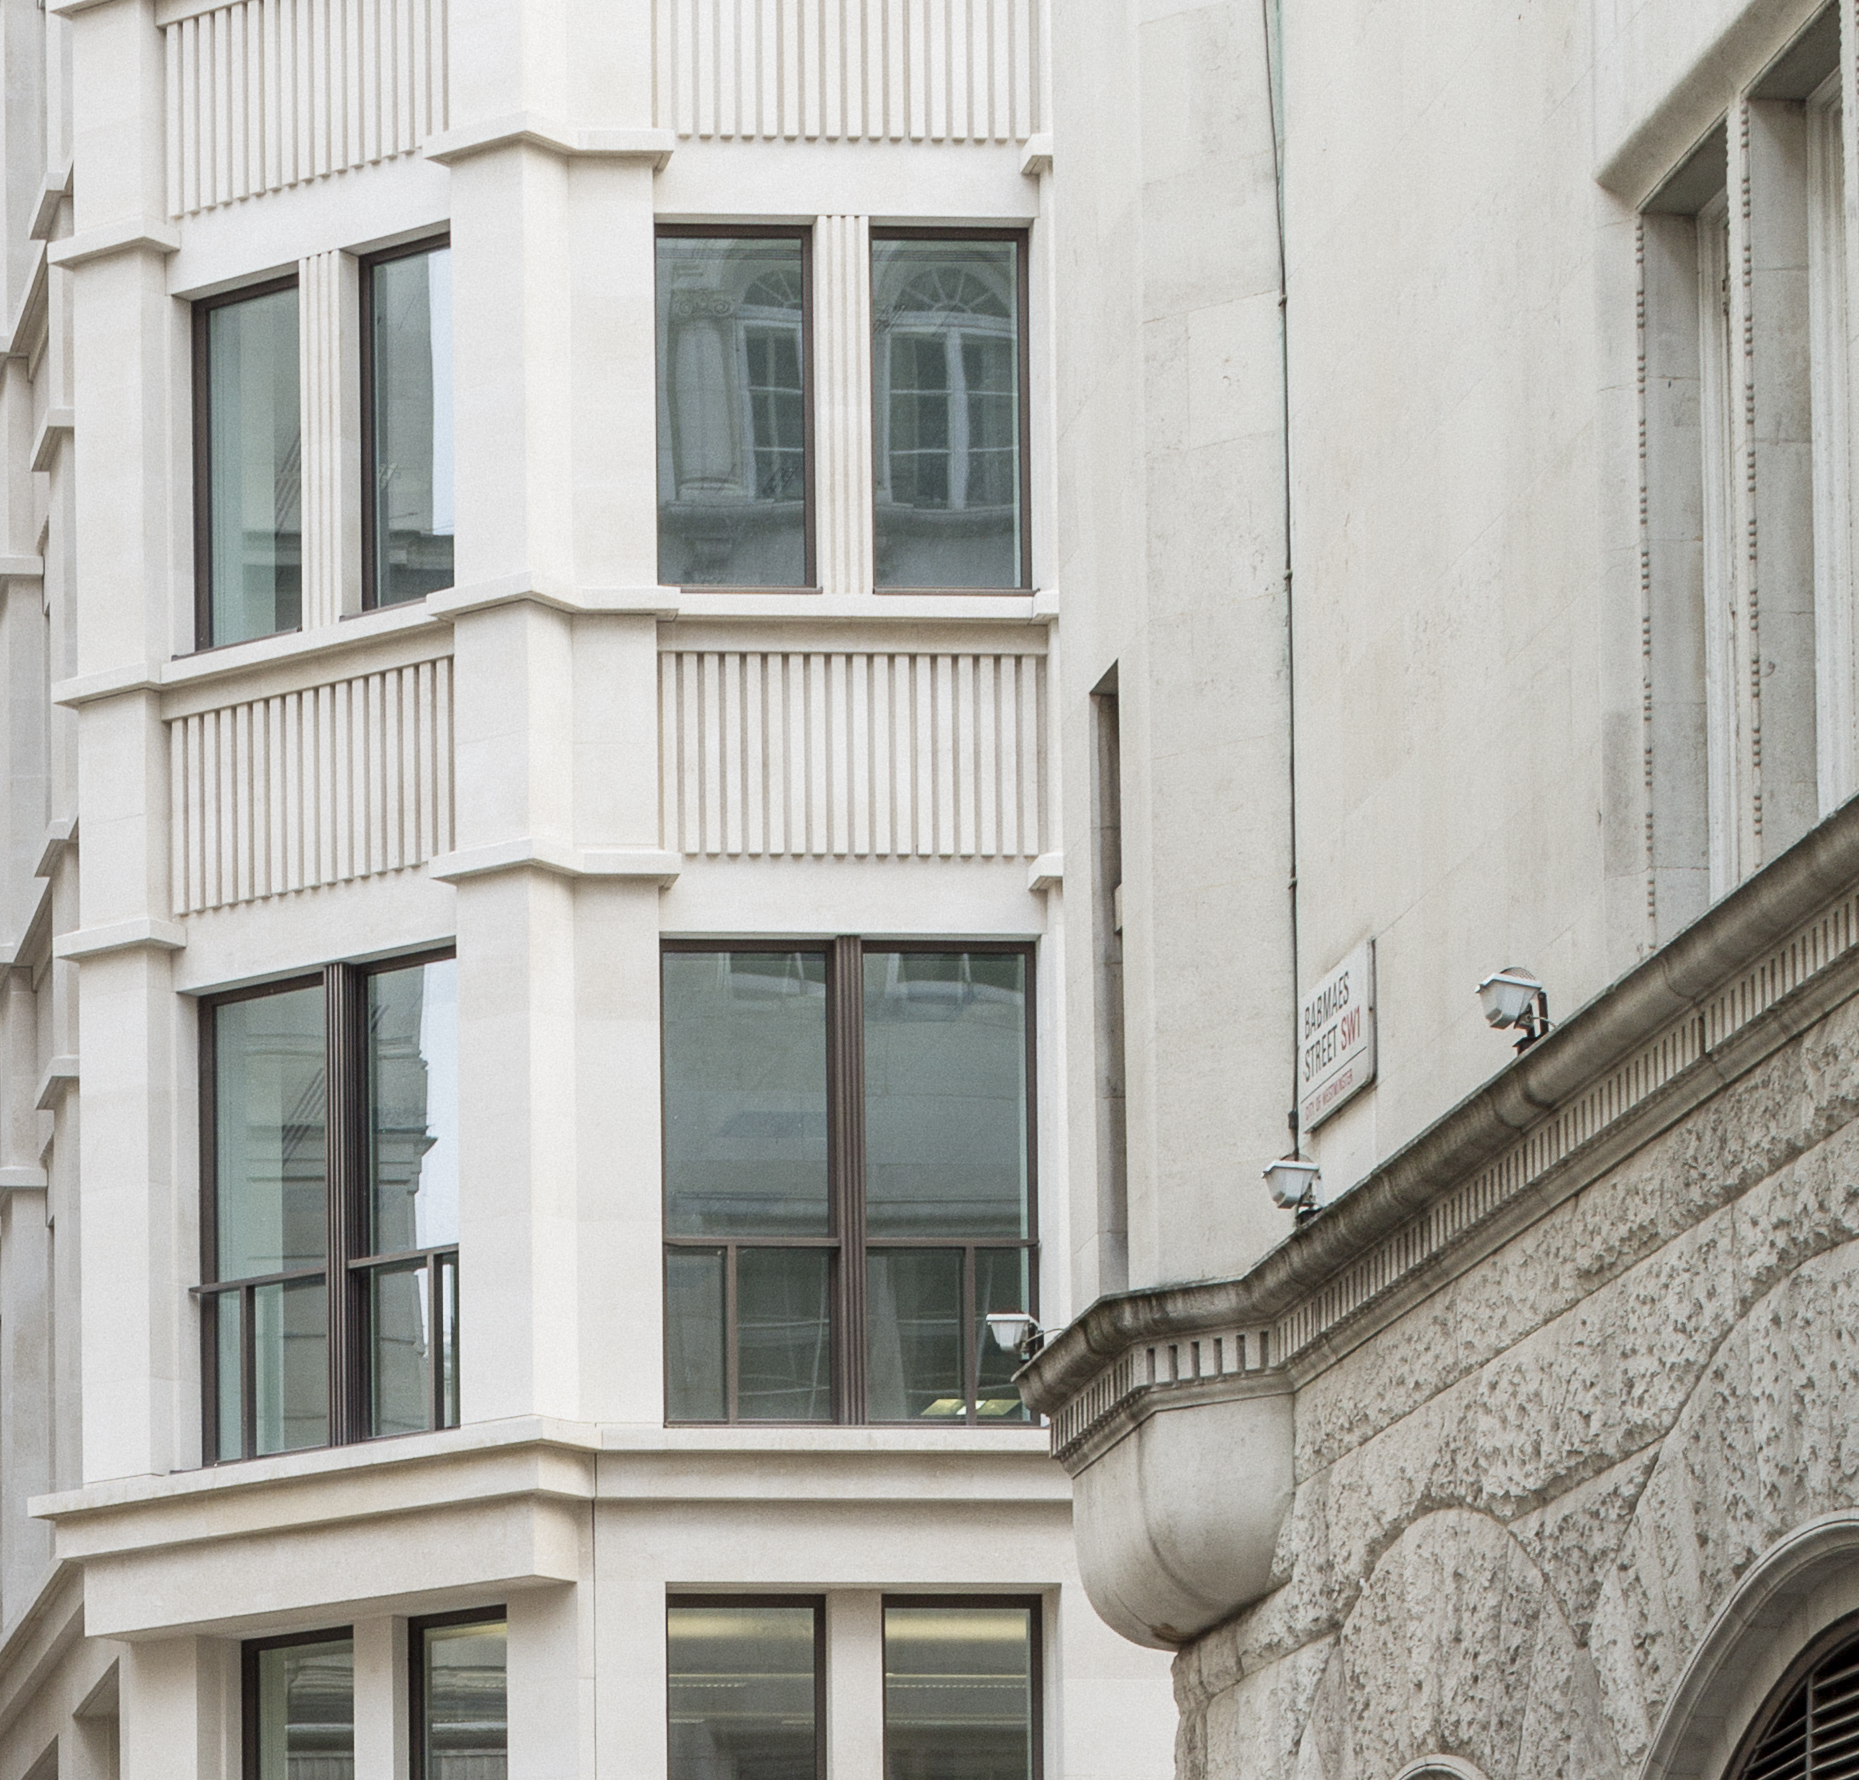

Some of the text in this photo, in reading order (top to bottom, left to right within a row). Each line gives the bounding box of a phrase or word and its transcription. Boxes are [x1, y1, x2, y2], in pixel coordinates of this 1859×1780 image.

[1304, 970, 1349, 1041] BABMAES
[1304, 1005, 1361, 1082] STREET SW1
